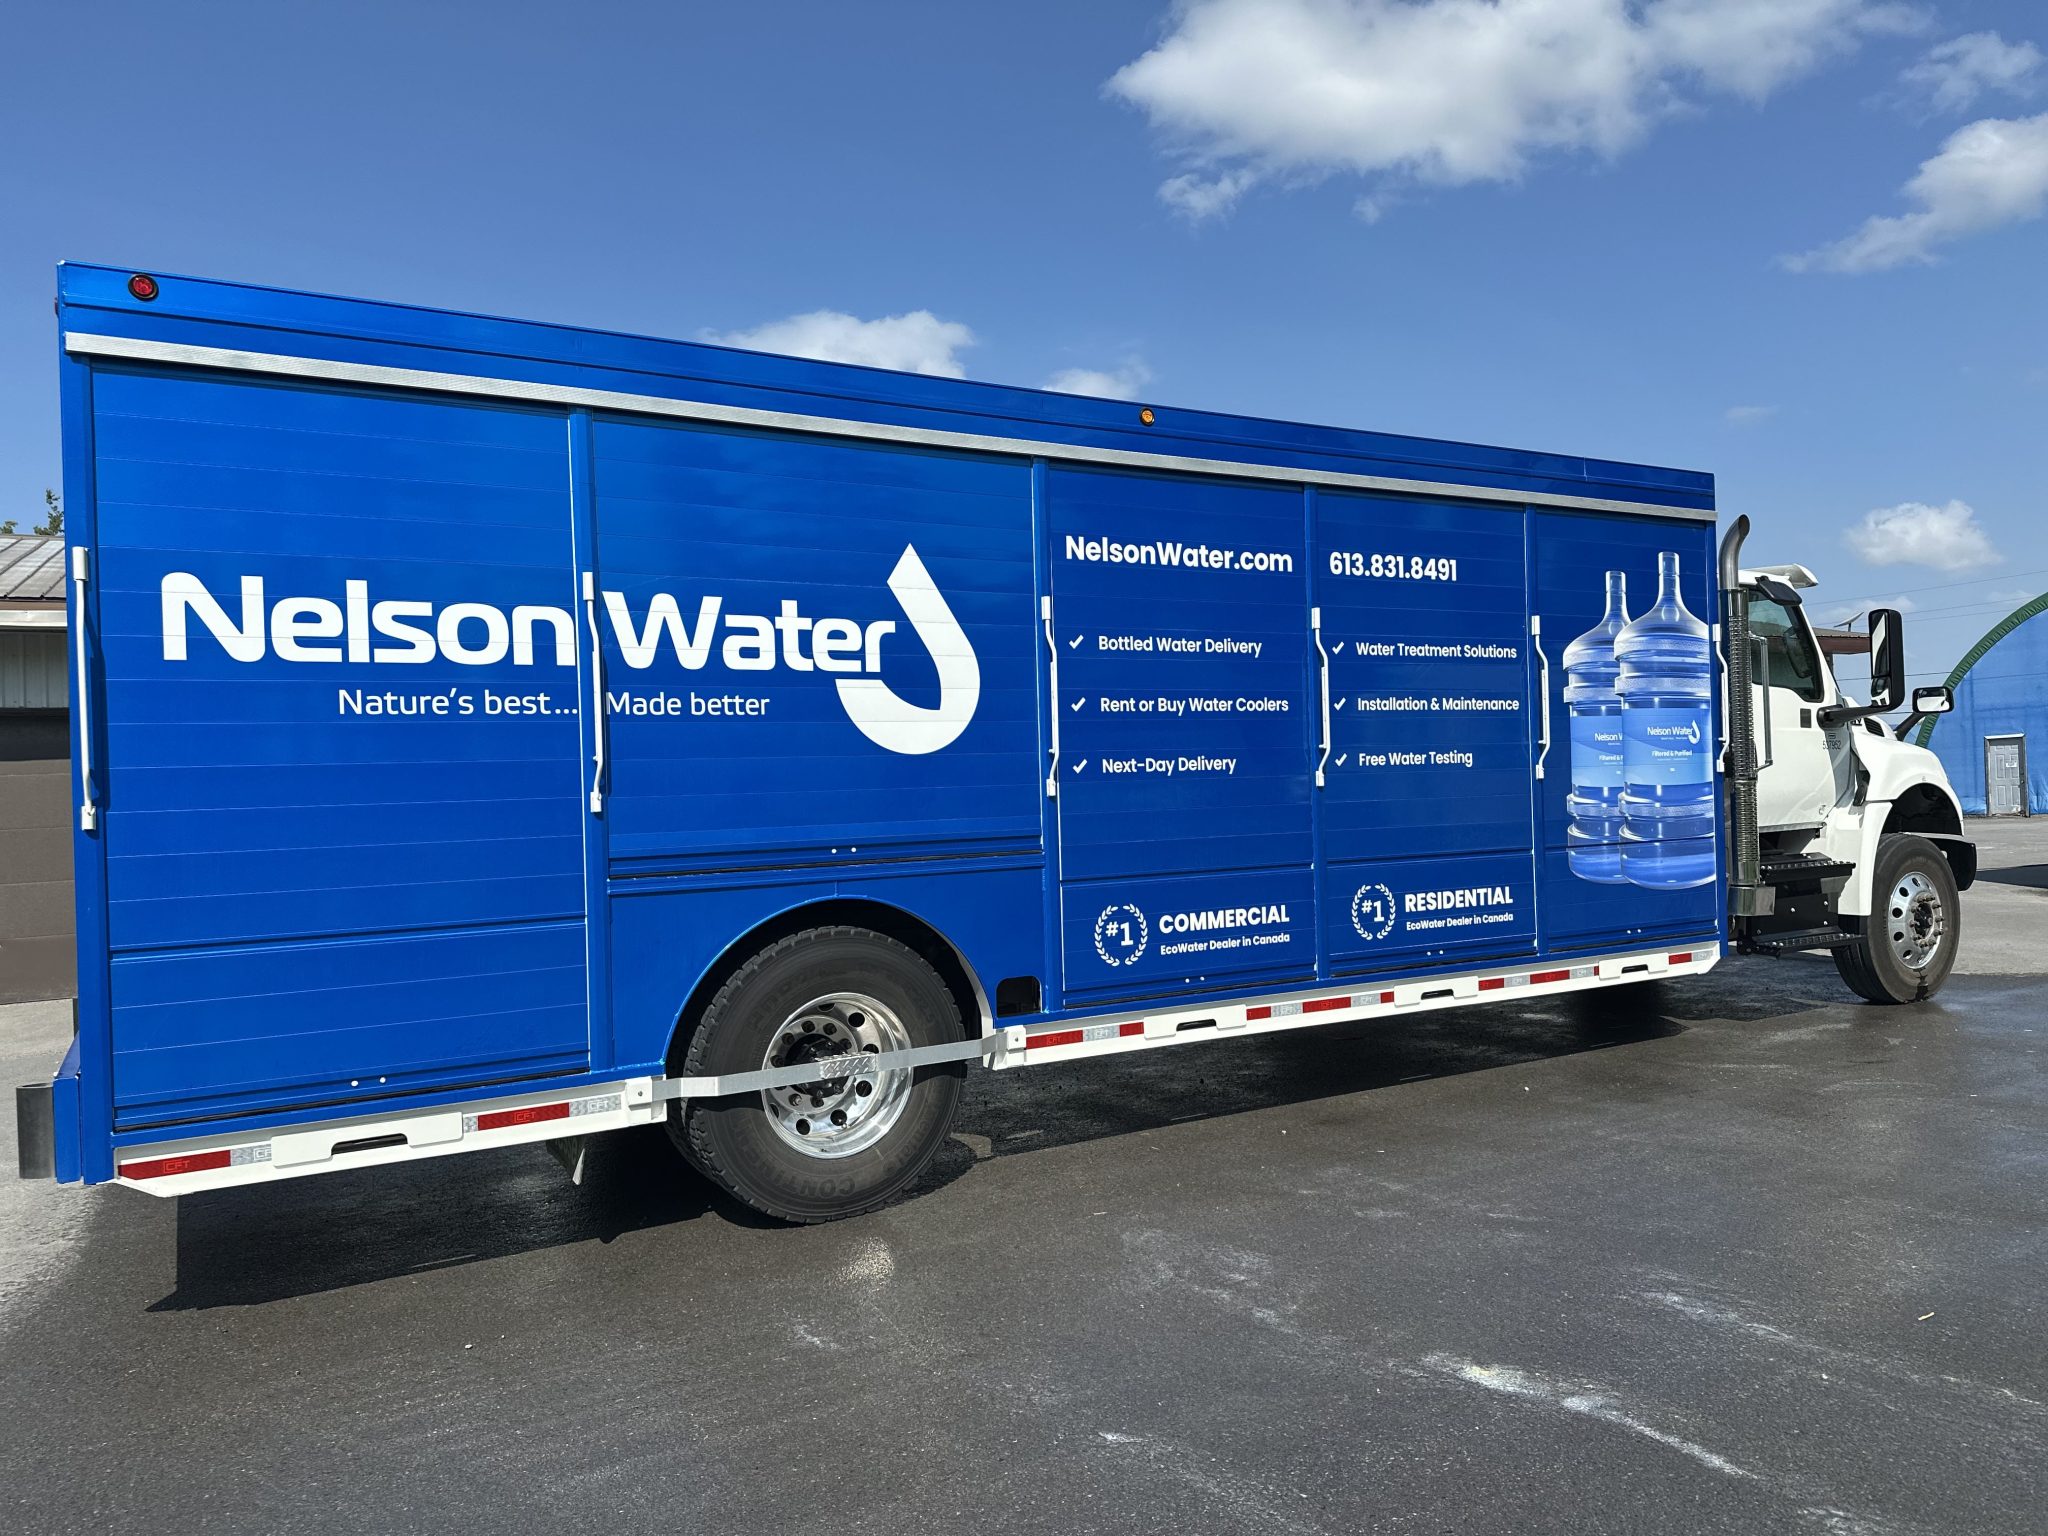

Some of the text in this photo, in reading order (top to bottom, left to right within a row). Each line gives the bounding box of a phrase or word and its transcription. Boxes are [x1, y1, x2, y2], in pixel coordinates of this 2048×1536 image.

[1066, 536, 1293, 573] NelsonWater.com
[1329, 551, 1457, 582] 613.831.8491
[161, 572, 896, 673] Nelson Water
[1098, 636, 1263, 658] Bottled Water Delivery
[1355, 642, 1517, 659] Water Treatment Solutions
[339, 687, 770, 716] Nature's best... Made better
[1100, 696, 1289, 717] Rent or Buy Water Coolers
[1357, 697, 1520, 711] Installation & Maintenance
[1103, 756, 1237, 777] Next-Day Delivery
[1358, 750, 1473, 768] Free Water Testing
[1361, 900, 1385, 922] #1
[1404, 886, 1514, 913] RESIDENTIAL
[1158, 904, 1290, 934] COMMERCIAL
[1406, 912, 1514, 932] EcoWater Dealer in Canada
[1106, 922, 1134, 946] #1
[1160, 932, 1291, 956] EcoWater Dealer in Canada
